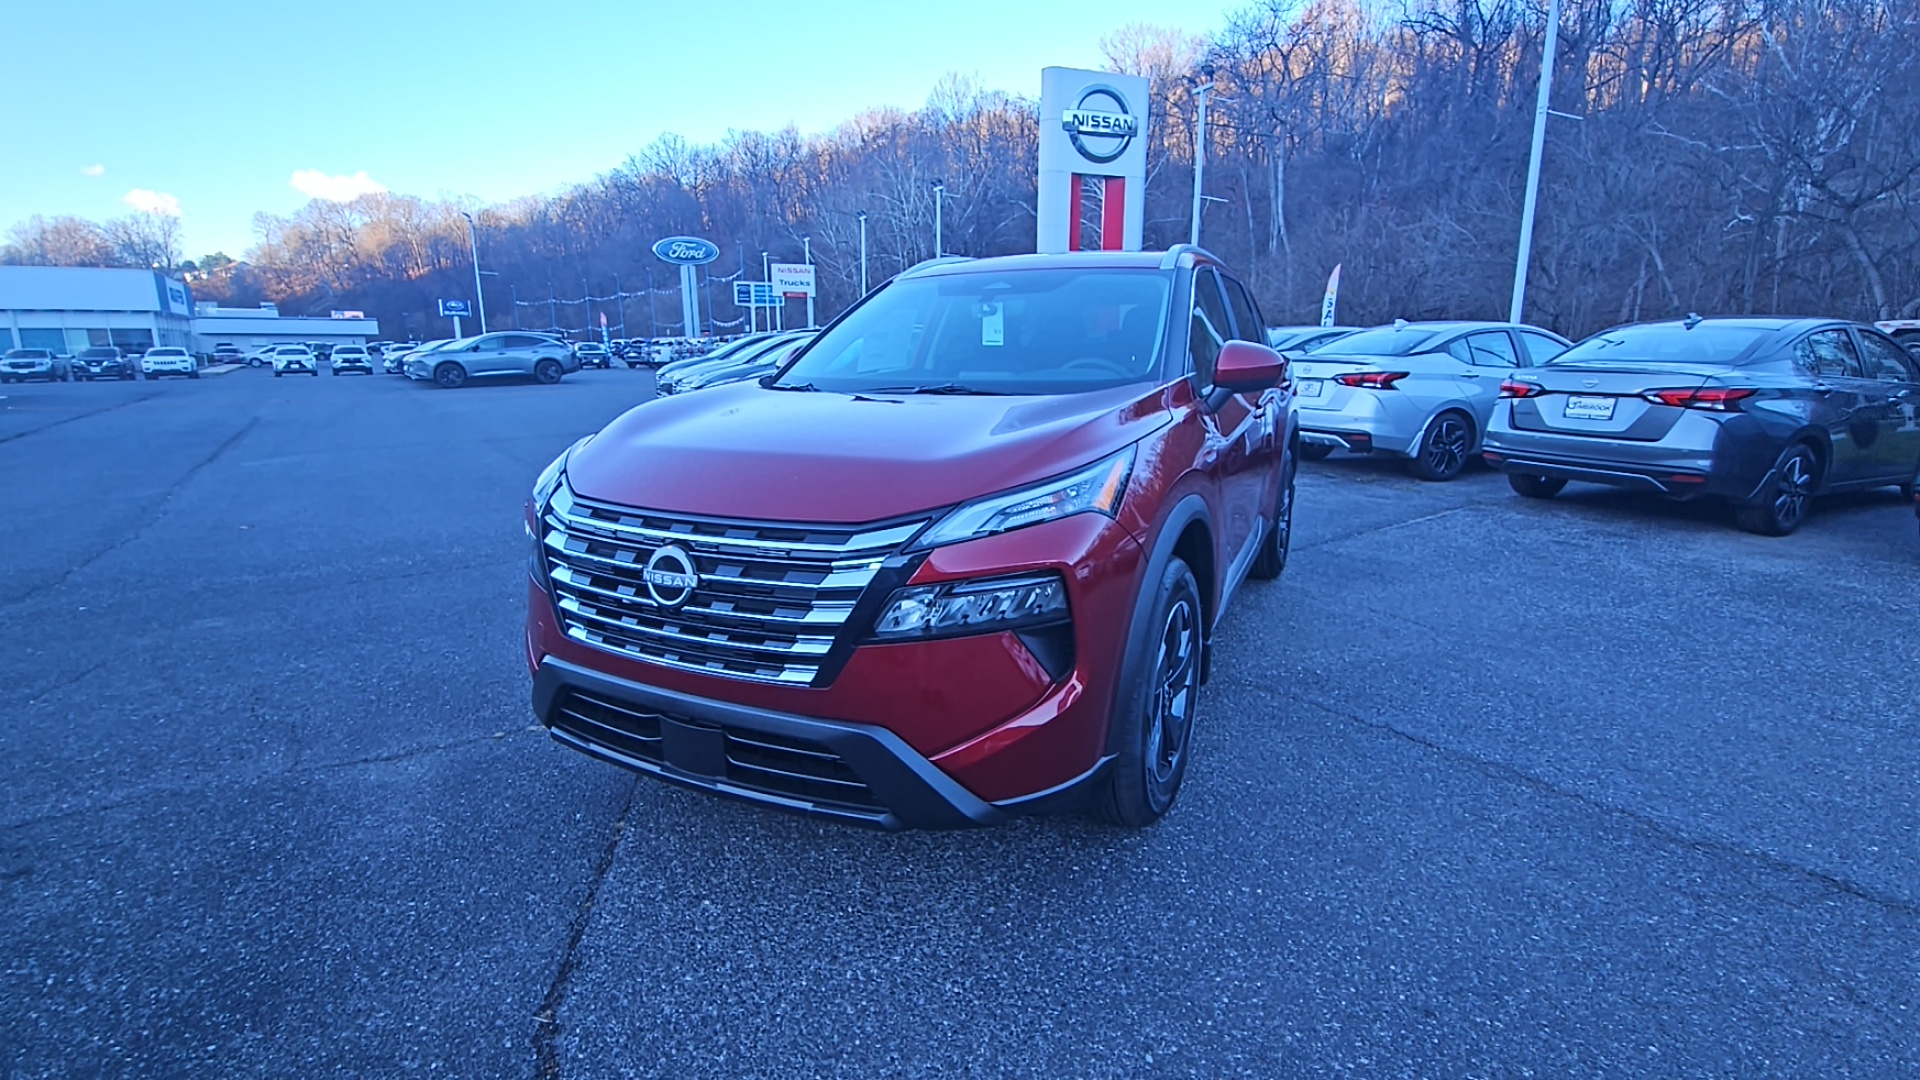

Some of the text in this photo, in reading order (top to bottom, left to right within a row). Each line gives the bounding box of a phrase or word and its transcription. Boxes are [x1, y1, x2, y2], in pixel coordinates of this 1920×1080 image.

[1071, 113, 1133, 131] NISSAN
[668, 241, 706, 259] Ford
[779, 279, 811, 287] Trucks
[643, 568, 697, 587] NISSAN
